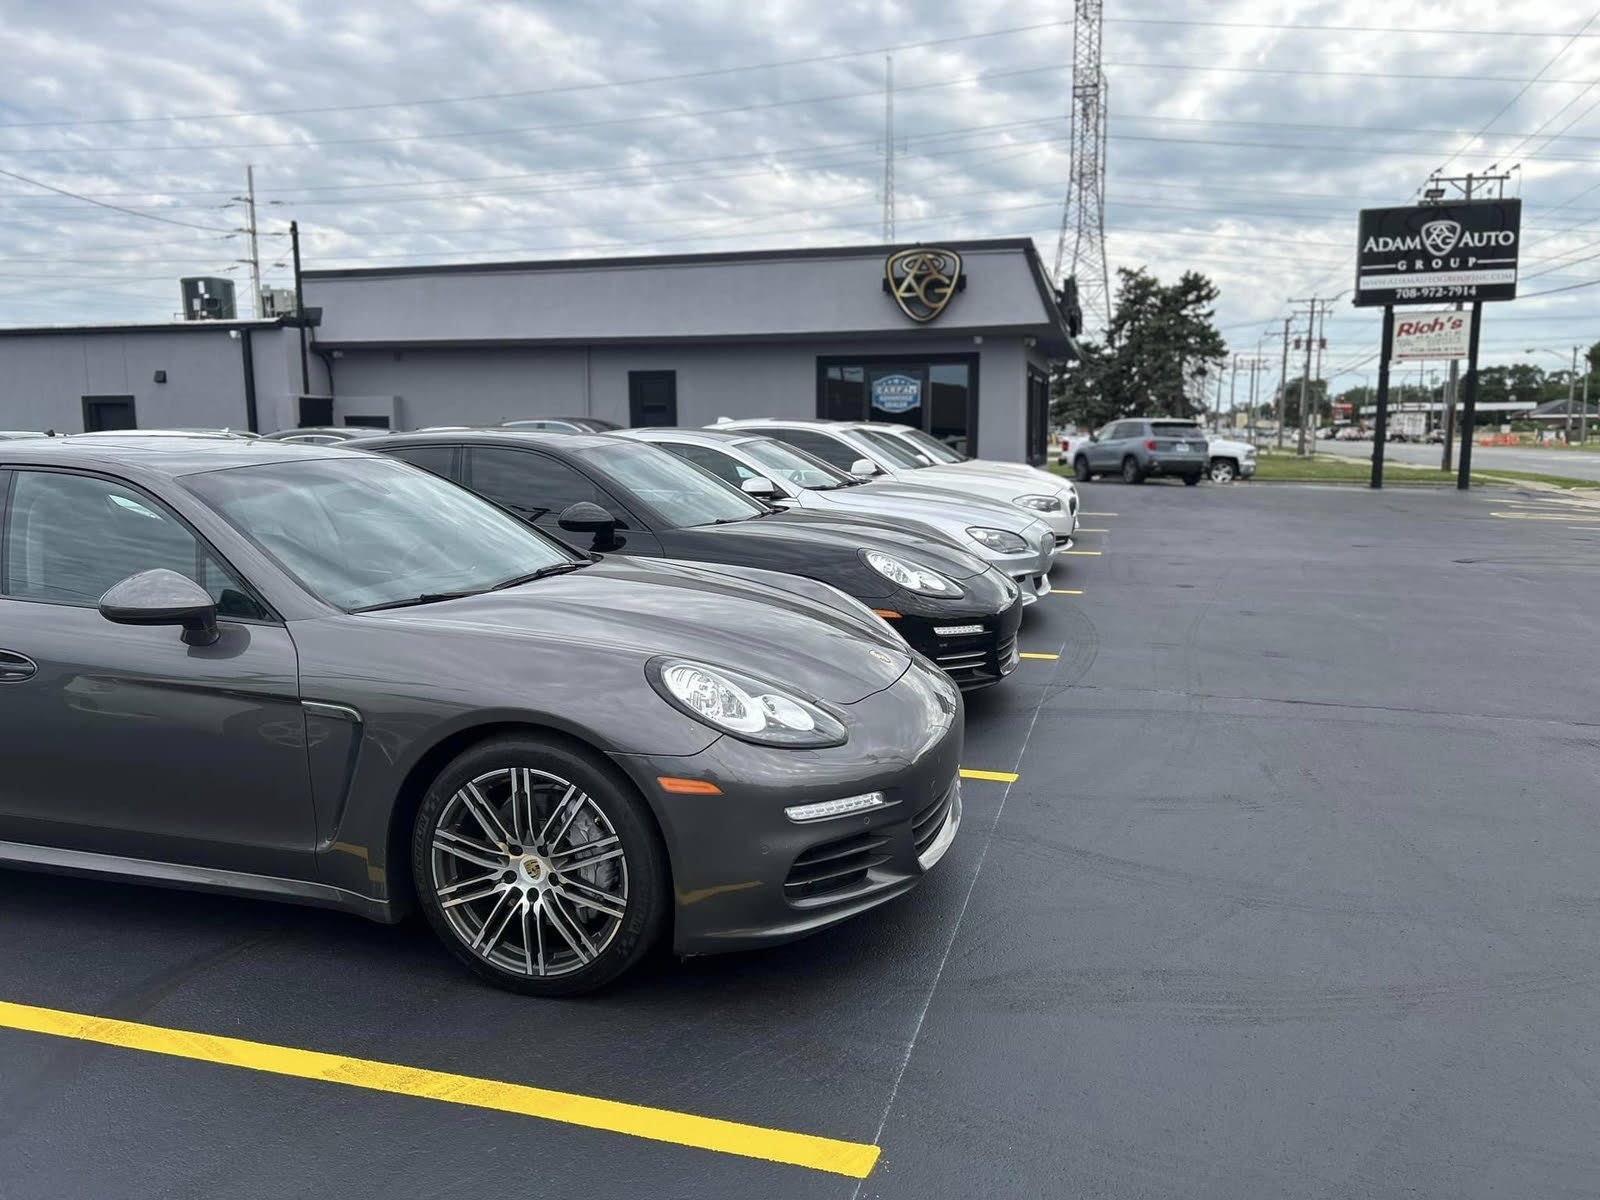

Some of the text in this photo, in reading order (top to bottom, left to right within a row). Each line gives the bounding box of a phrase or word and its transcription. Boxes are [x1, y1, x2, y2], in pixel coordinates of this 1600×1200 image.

[1363, 231, 1515, 253] ADAM AUTO
[1397, 257, 1478, 270] GROUP
[1395, 286, 1477, 299] 708-972-7914
